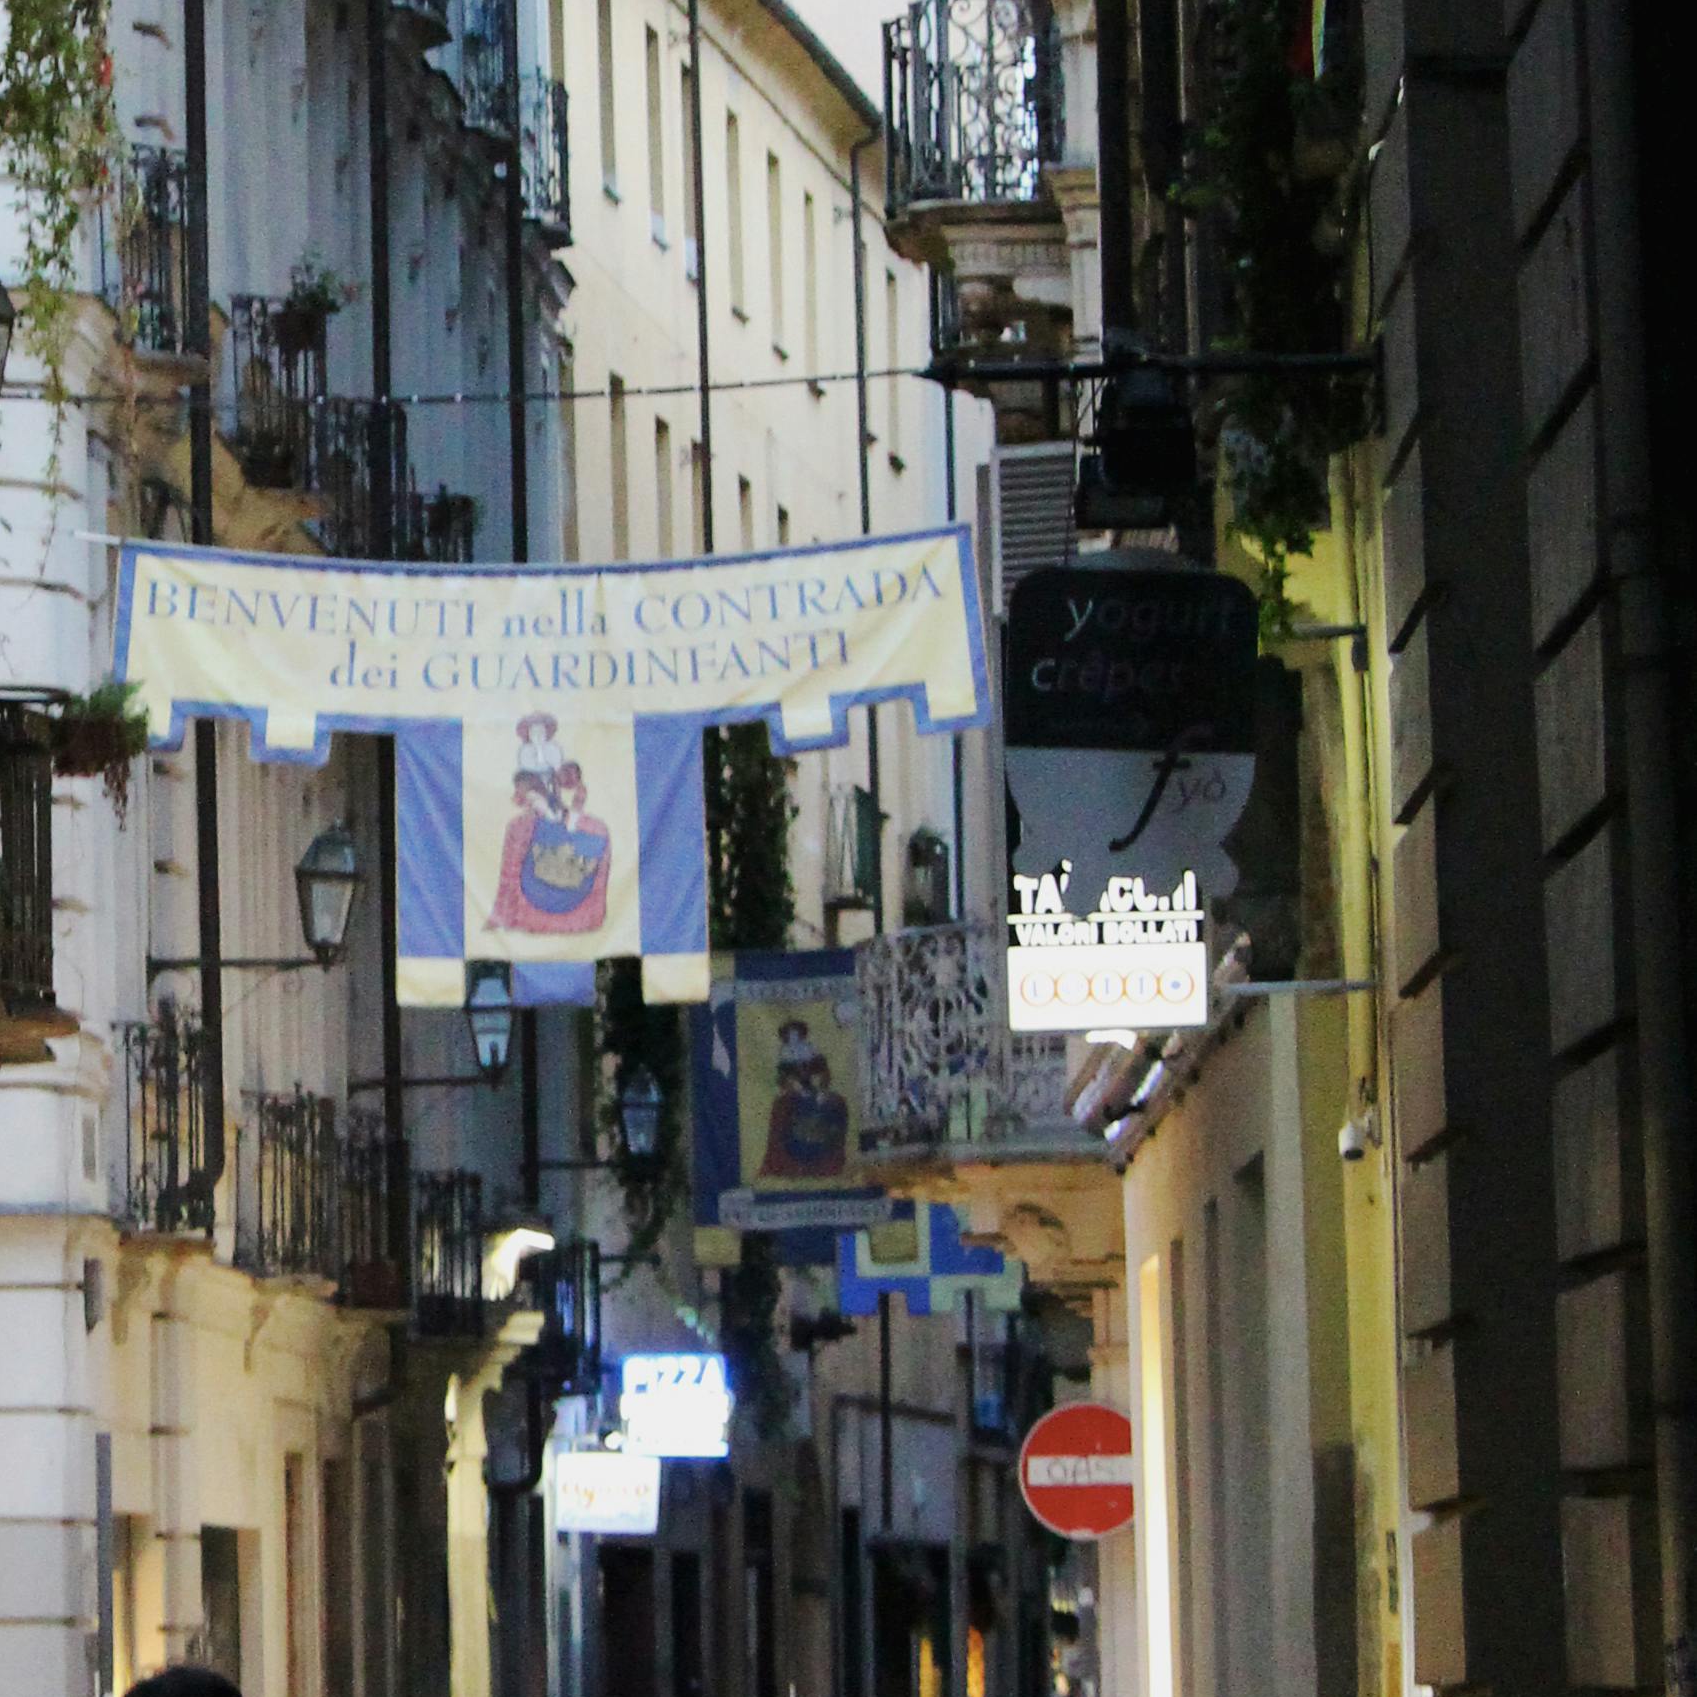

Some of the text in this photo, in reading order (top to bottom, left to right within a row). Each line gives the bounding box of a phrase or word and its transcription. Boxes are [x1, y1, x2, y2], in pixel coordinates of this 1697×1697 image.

[147, 561, 943, 638] BENVENUTI nella CONTRADA
[329, 630, 851, 690] dei GUARDINFANTI
[1015, 919, 1197, 947] VALORI BOLLATI
